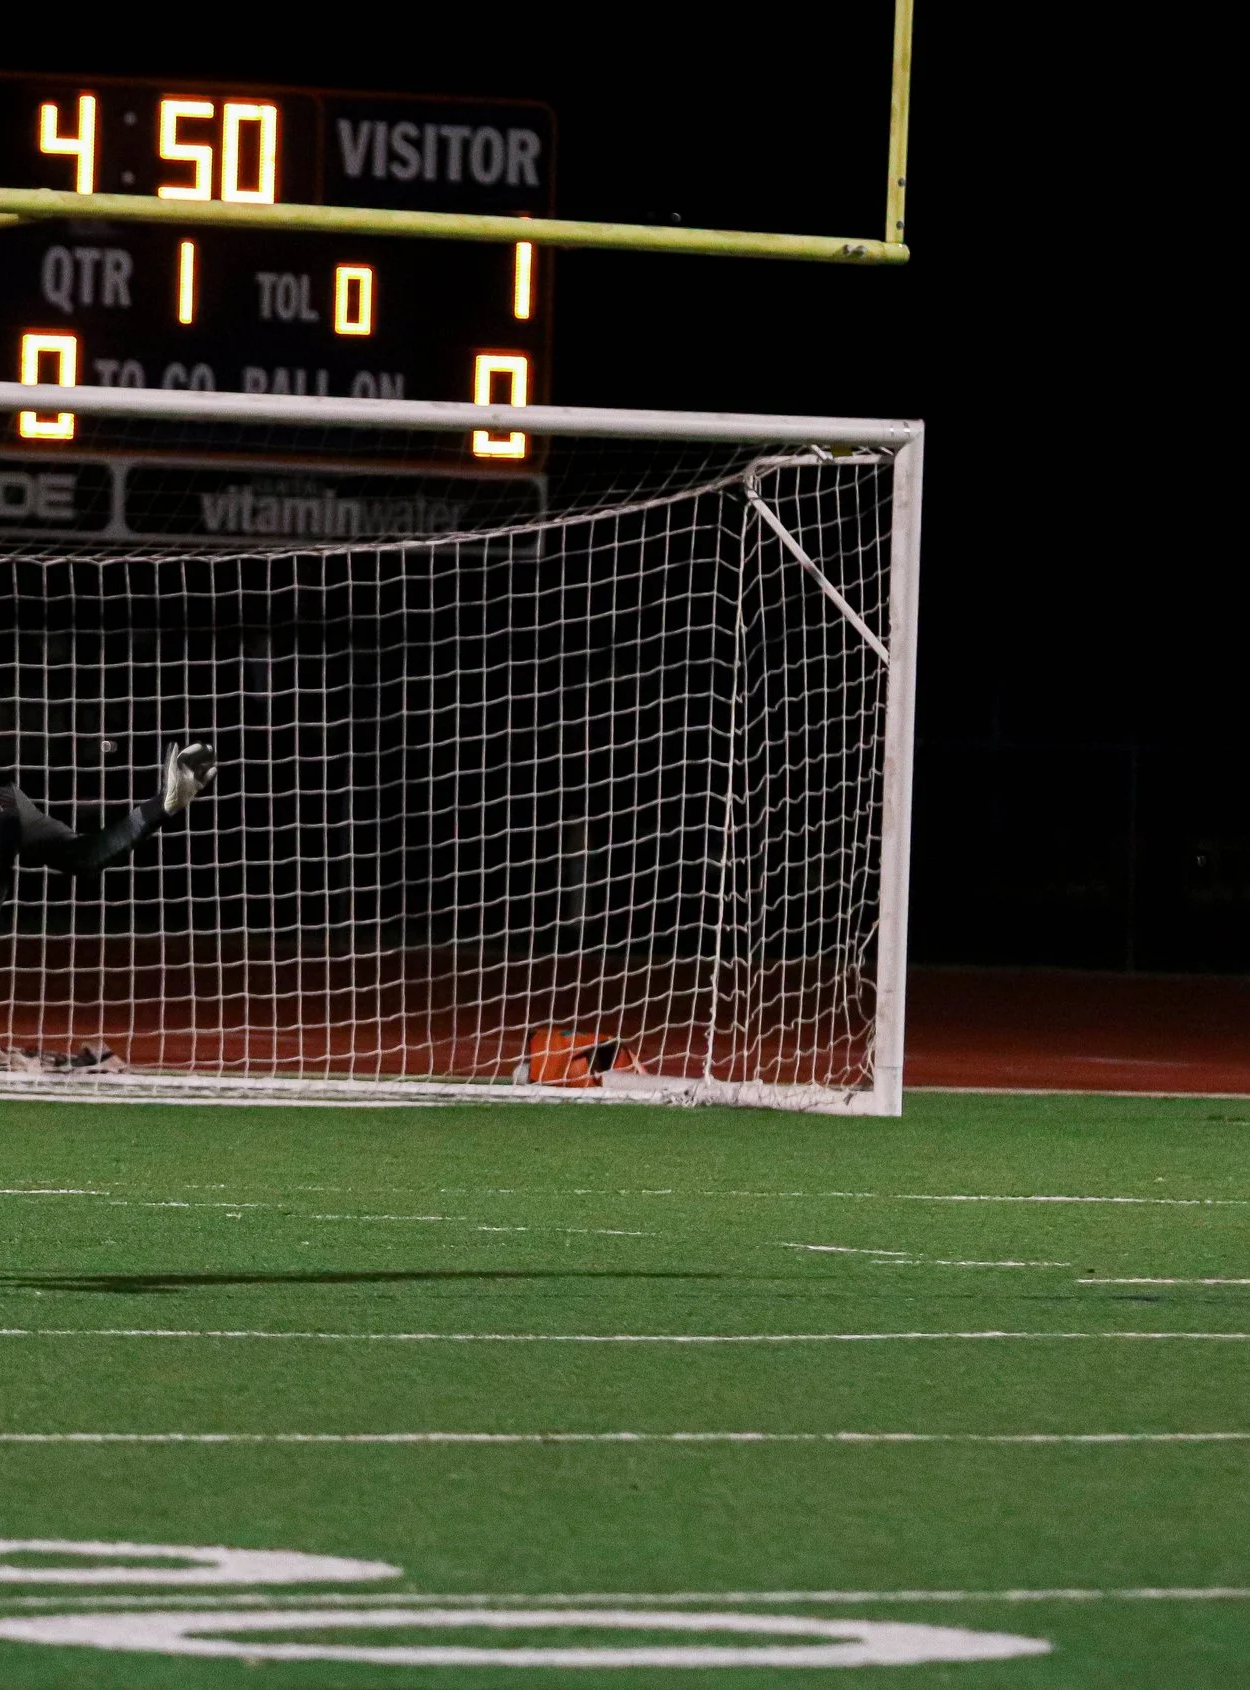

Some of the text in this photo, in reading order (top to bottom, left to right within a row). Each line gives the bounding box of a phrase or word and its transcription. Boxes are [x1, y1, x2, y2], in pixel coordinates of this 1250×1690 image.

[336, 117, 542, 187] VISITOR
[41, 245, 135, 316] QTR
[177, 240, 196, 325] 1
[255, 271, 320, 323] TOL
[334, 266, 373, 336] 0
[513, 241, 533, 320] 1
[19, 333, 78, 440] 0
[474, 354, 528, 459] 0
